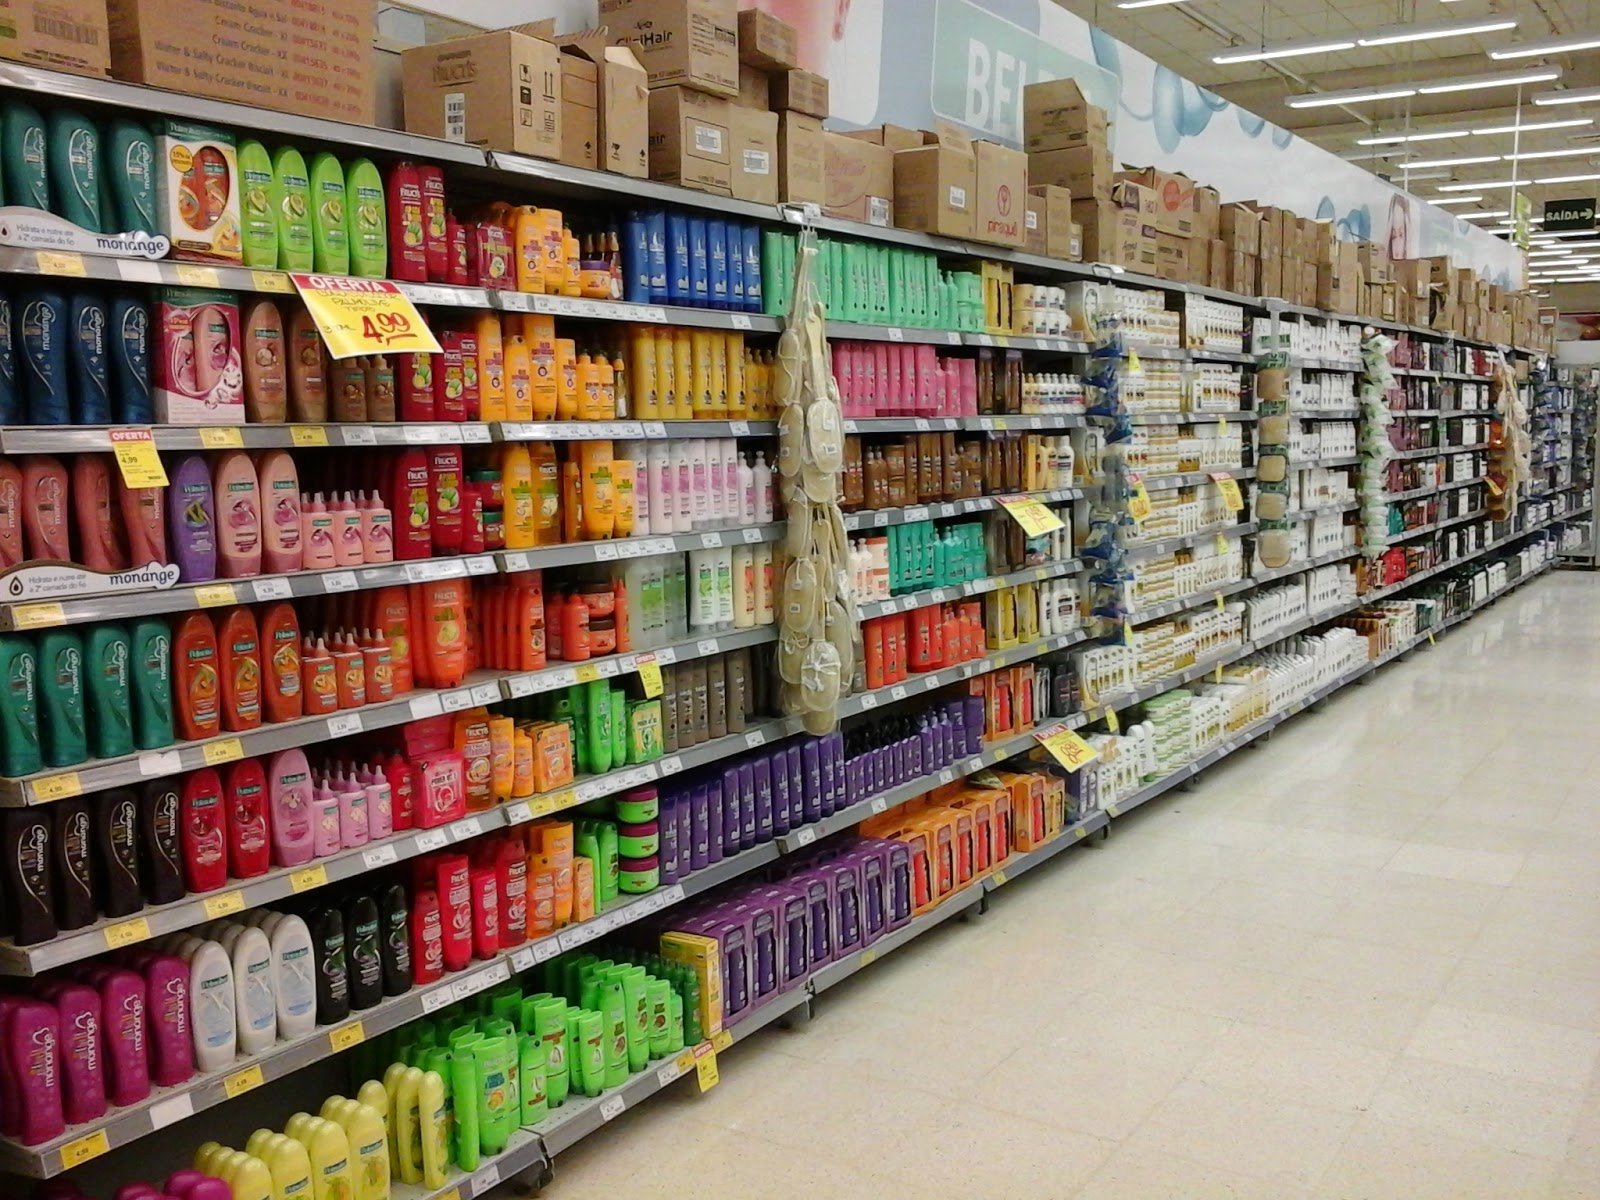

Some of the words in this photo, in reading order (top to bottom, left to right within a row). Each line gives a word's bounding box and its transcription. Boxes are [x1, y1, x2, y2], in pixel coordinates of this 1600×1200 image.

[309, 276, 387, 292] OFERTA
[362, 312, 418, 346] 4,99
[111, 431, 151, 441] OFERTA
